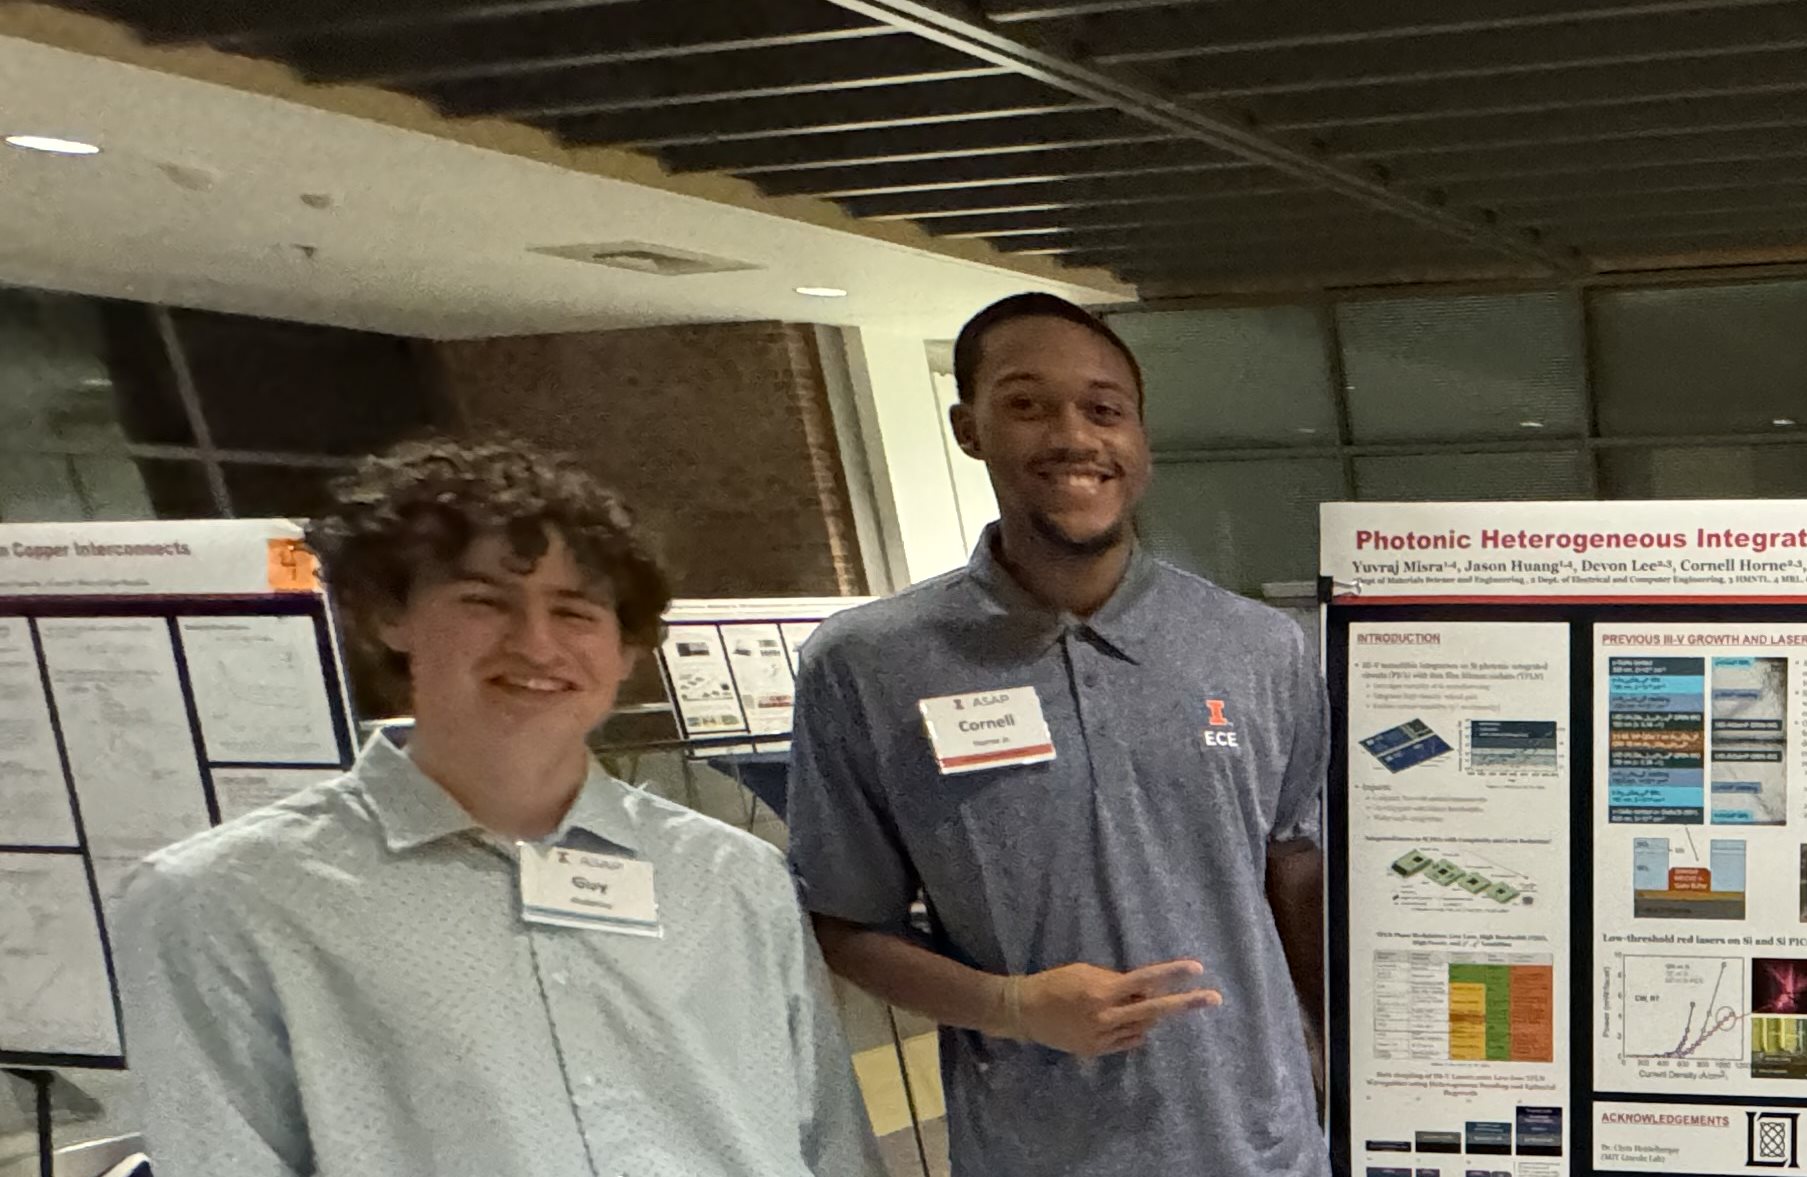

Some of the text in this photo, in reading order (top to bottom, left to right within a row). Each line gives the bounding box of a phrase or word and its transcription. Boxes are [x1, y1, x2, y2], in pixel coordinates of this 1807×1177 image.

[1356, 529, 1472, 550] Photonic
[1481, 528, 1687, 554] Heterogeneous
[12, 540, 192, 560] Copper Interconnects
[1352, 560, 1400, 575] Yuvraj
[1464, 559, 1507, 573] Jason
[1582, 558, 1627, 572] Devon
[1680, 558, 1735, 572] Cornell
[1357, 633, 1441, 645] INTRODUCTION
[1602, 634, 1660, 645] PREVIOUS
[1663, 634, 1684, 645] III-V
[1688, 634, 1740, 645] GROWTH
[1743, 634, 1767, 645] AND
[958, 713, 1015, 732] Cornell
[1203, 730, 1239, 748] ECE
[1602, 934, 1675, 944] Low-threshold
[1676, 935, 1694, 944] red
[1696, 935, 1725, 945] lasers
[1727, 937, 1741, 945] on
[1743, 935, 1753, 946] Si
[1755, 936, 1774, 946] and
[1776, 936, 1786, 946] Si
[1601, 1112, 1730, 1127] ACKNOWLEDGEMENTS
